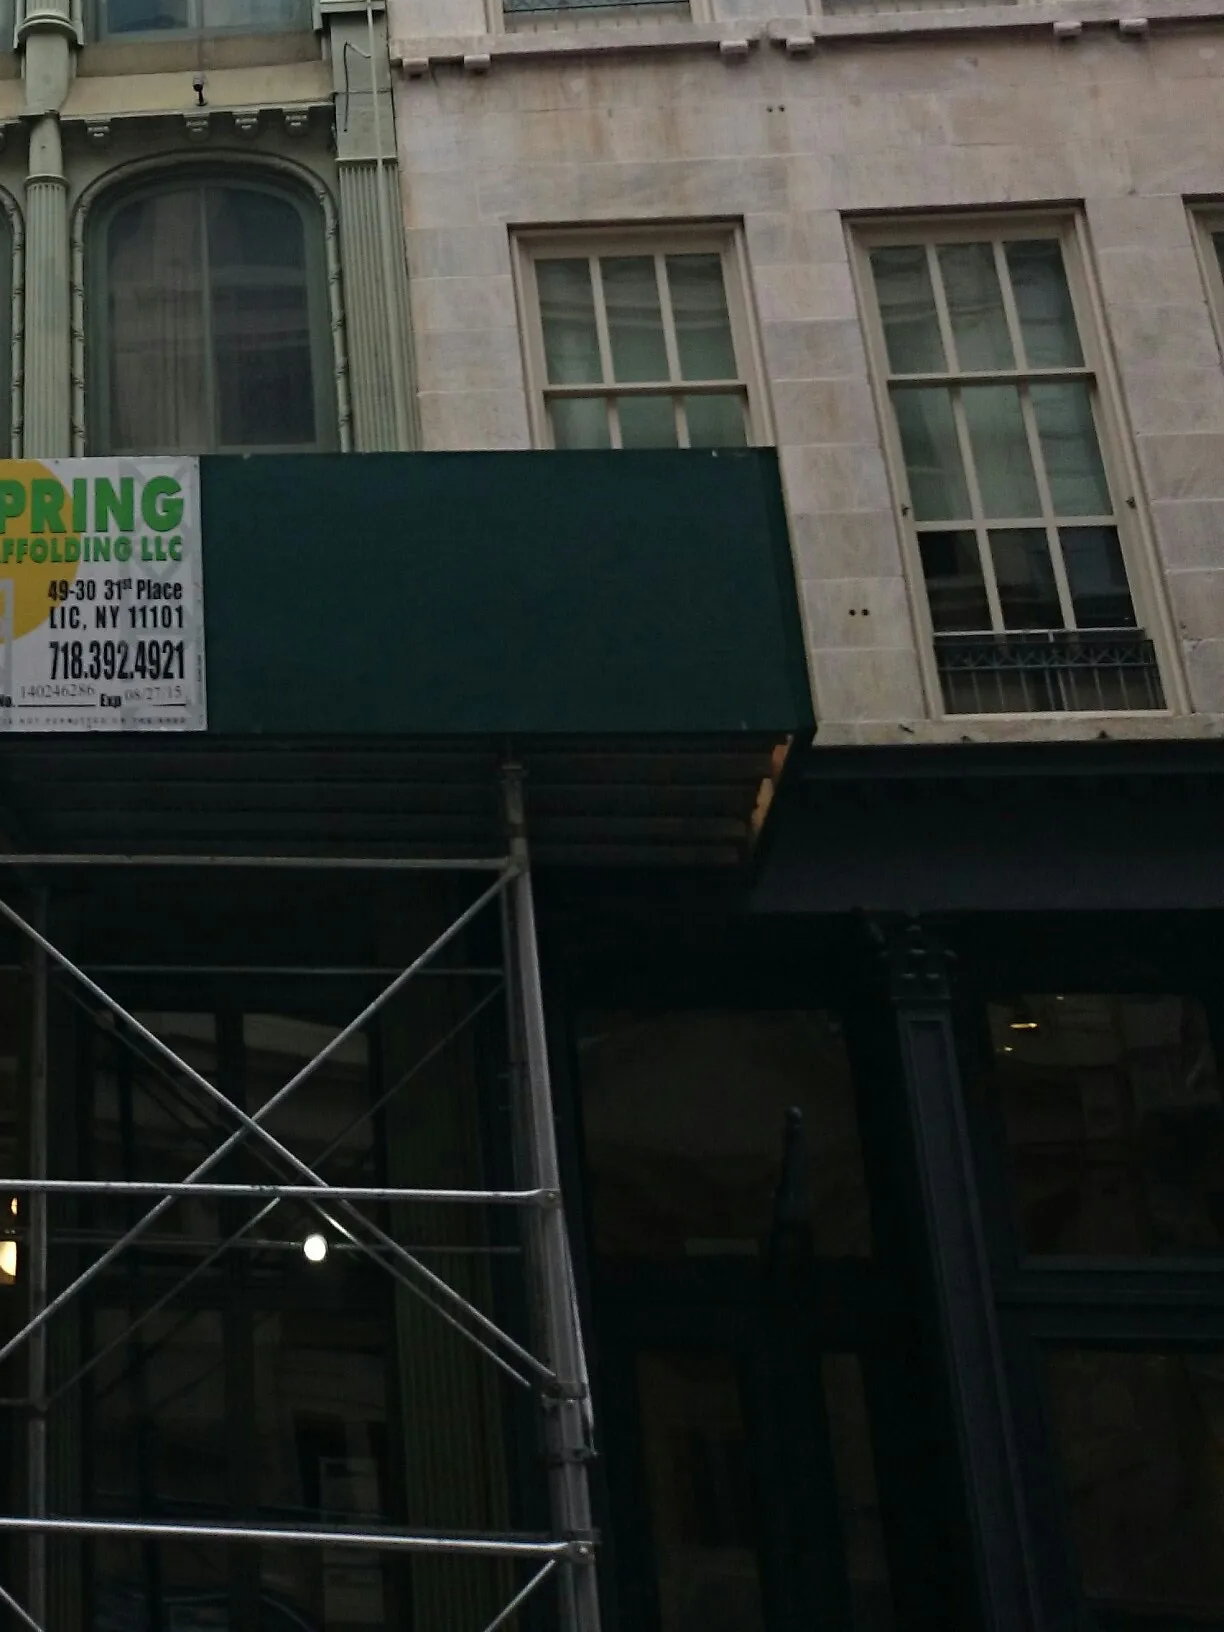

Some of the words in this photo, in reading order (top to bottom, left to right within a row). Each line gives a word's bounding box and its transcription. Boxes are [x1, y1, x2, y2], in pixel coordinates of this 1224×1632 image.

[141, 536, 183, 562] LLC
[48, 579, 97, 601] 49-30
[104, 577, 133, 601] 31st
[136, 578, 183, 600] Place
[49, 605, 87, 631] LIC,
[95, 605, 120, 629] NY
[129, 604, 184, 629] 11101
[49, 639, 185, 680] 718.392.4921
[99, 693, 122, 710] Exp
